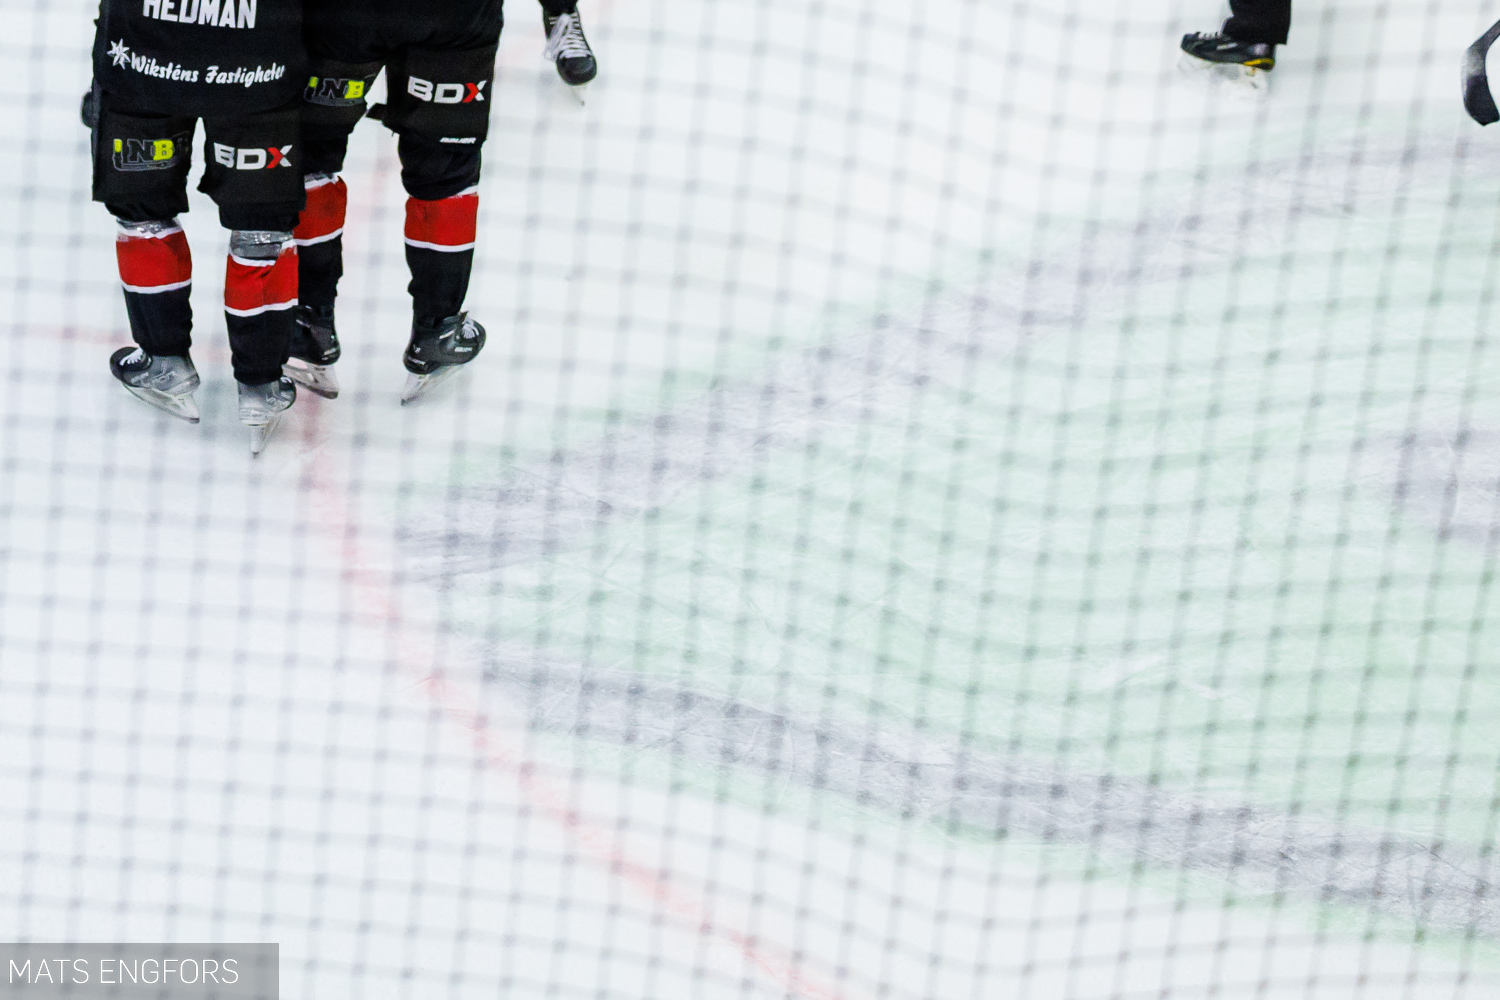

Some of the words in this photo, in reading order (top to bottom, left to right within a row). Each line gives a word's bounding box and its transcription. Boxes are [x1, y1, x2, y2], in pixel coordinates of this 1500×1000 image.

[131, 52, 199, 83] Wiksténs
[408, 76, 488, 104] BDX
[213, 143, 293, 170] BDX
